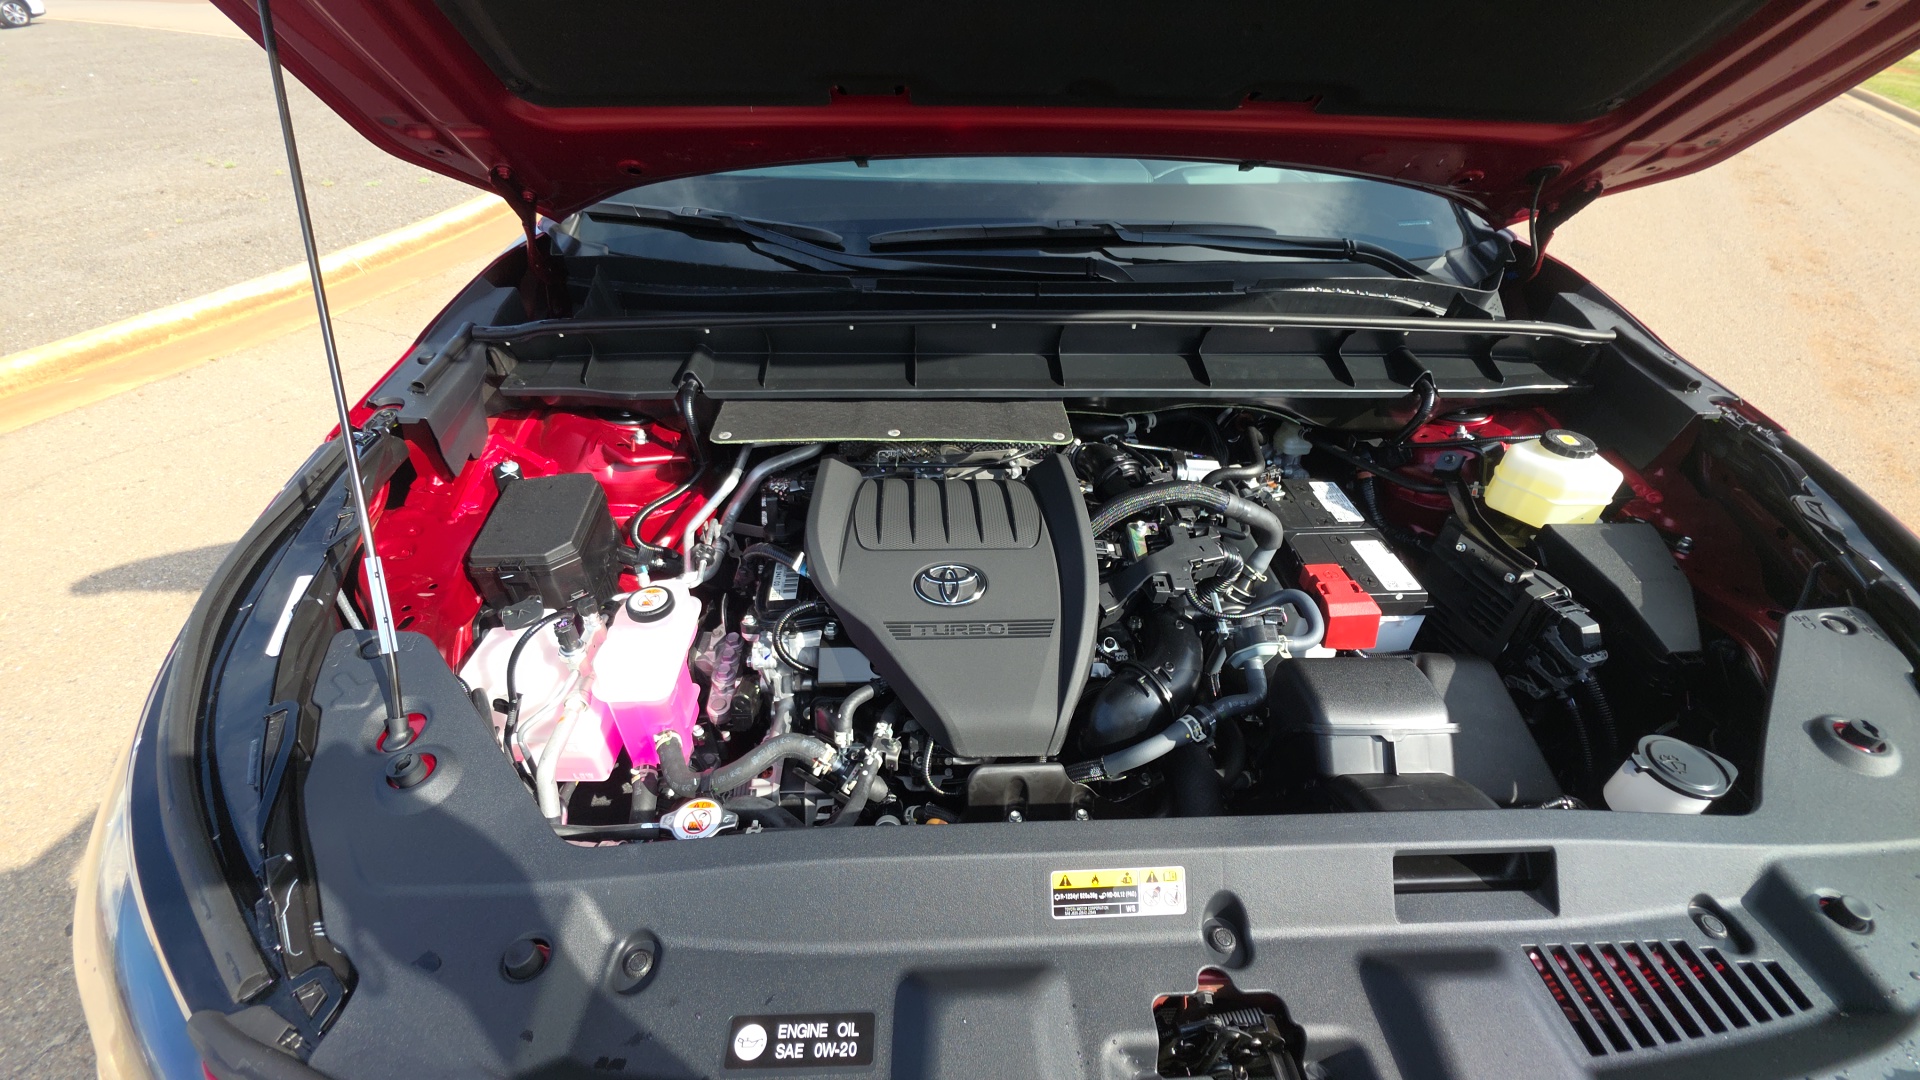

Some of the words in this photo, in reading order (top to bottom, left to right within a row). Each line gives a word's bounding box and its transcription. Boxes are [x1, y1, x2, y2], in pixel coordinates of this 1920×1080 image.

[911, 623, 1006, 636] TURBO
[777, 1022, 829, 1039] ENGINE
[837, 1022, 860, 1038] OIL
[775, 1042, 805, 1059] SAE
[813, 1042, 858, 1059] 0W-20
